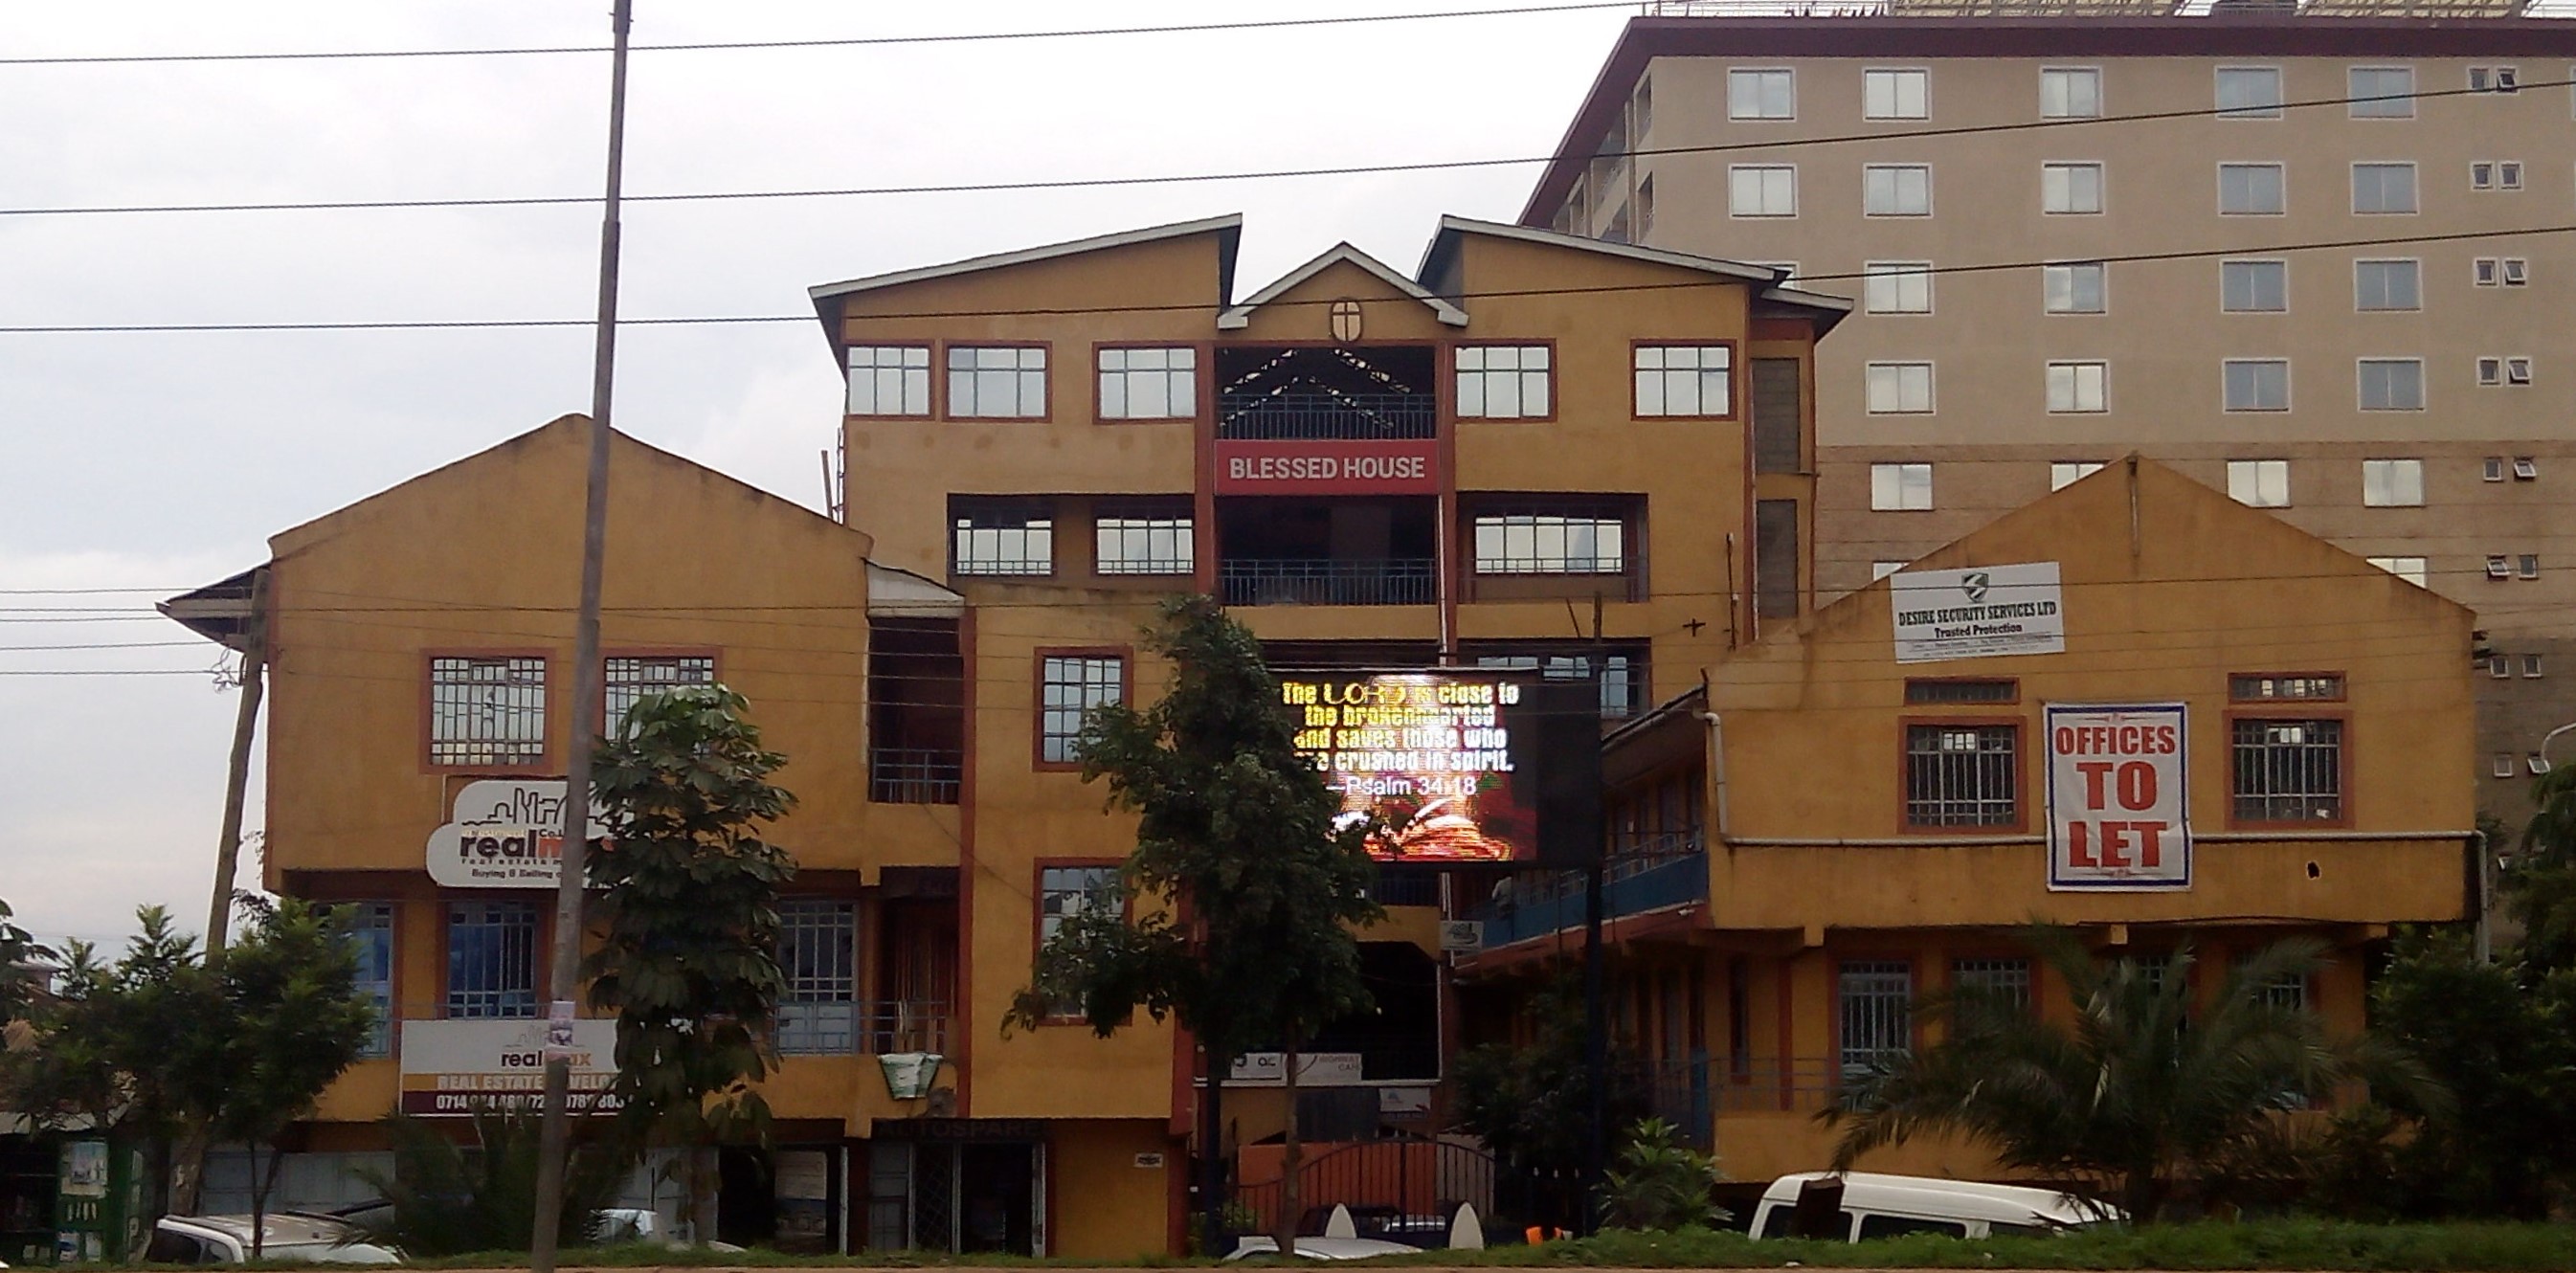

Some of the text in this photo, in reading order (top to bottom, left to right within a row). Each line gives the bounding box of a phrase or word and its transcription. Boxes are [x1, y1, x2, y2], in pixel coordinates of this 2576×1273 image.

[1229, 457, 1425, 480] BLESSED HOUSE
[1898, 600, 2056, 627] DESIRE SECURITY SERVICES LTD
[1935, 622, 2023, 638] Trusted Protection
[1282, 681, 1318, 704] The
[1438, 681, 1493, 704] close
[1498, 681, 1520, 704] to
[1335, 728, 1397, 748] saves
[1463, 727, 1507, 748] who
[2055, 726, 2176, 754] OFFICES
[2076, 760, 2158, 811] TO
[2068, 820, 2167, 868] LET
[437, 1075, 478, 1090] REAL
[483, 1075, 544, 1090] ESTATE
